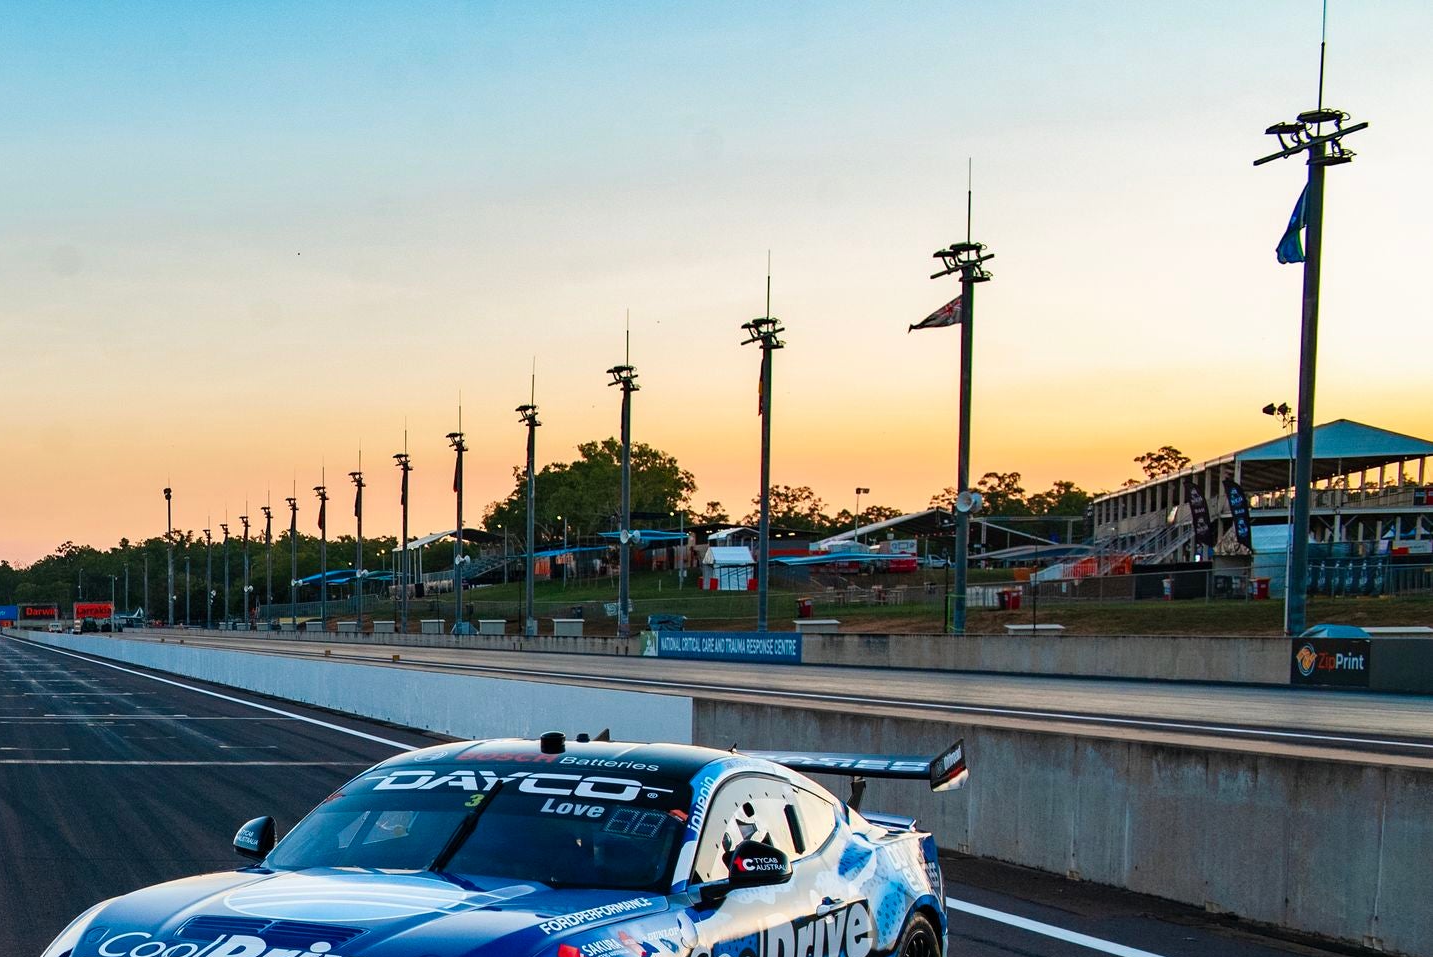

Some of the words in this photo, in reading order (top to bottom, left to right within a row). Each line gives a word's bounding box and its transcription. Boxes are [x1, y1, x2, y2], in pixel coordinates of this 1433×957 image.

[660, 637, 682, 652] NATIONAL
[682, 638, 701, 652] CRITICAL
[702, 638, 714, 652] CARE
[715, 638, 725, 653] AND
[725, 638, 746, 653] TRAUMA
[746, 638, 773, 655] RESPONSE
[774, 640, 797, 656] CENTRE
[1318, 652, 1365, 672] ZipPrint
[559, 756, 661, 772] Batteries
[372, 770, 643, 801] DAYCO
[464, 793, 485, 808] 3
[540, 798, 605, 818] Love
[687, 776, 714, 833] invenio
[581, 938, 624, 957] SAKURA
